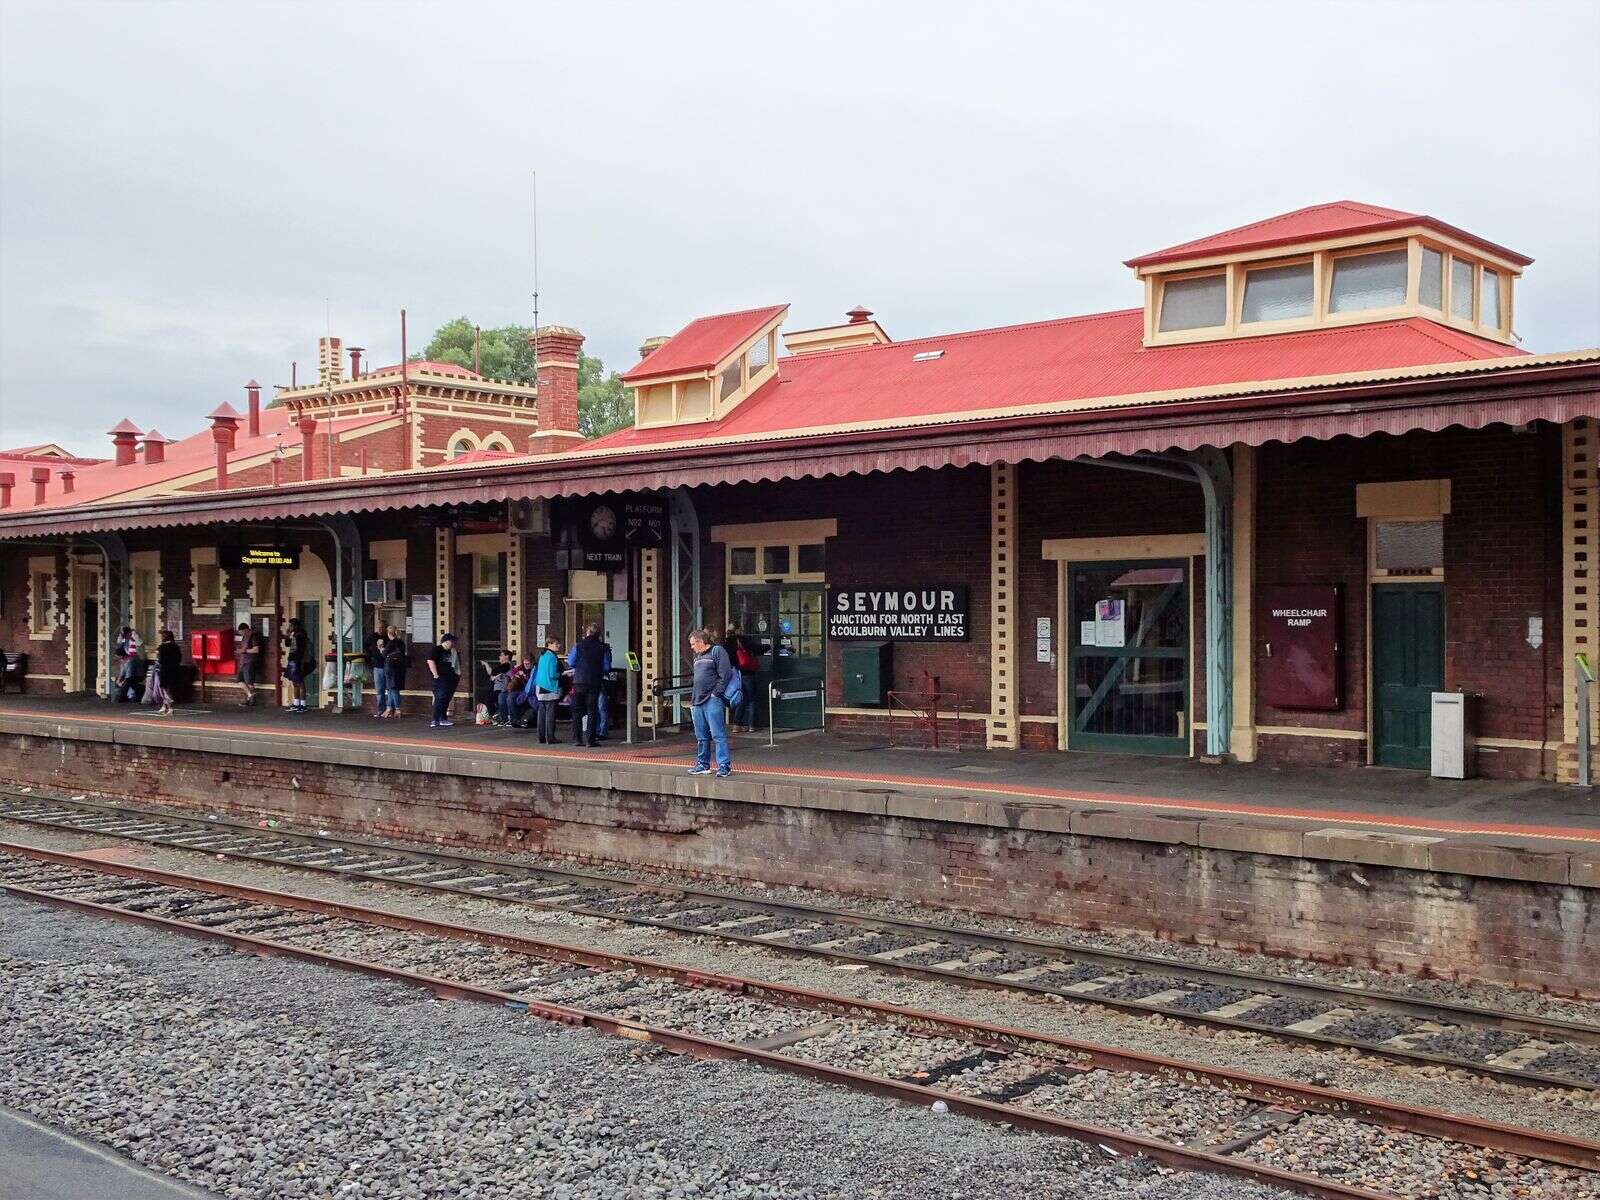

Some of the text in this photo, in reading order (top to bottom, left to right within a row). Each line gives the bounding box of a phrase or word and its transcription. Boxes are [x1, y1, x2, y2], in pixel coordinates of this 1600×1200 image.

[625, 504, 664, 513] PLATFORM
[241, 556, 268, 565] Seymour
[586, 553, 622, 561] NEXT TRAIN
[837, 590, 955, 612] SEYMOUR
[1272, 609, 1328, 617] WHEELCHAIR
[830, 613, 964, 625] JUNCTION FOR NORTH EAST
[1287, 618, 1312, 626] RAMP
[889, 626, 928, 637] VALLEY
[934, 625, 965, 637] LINES
